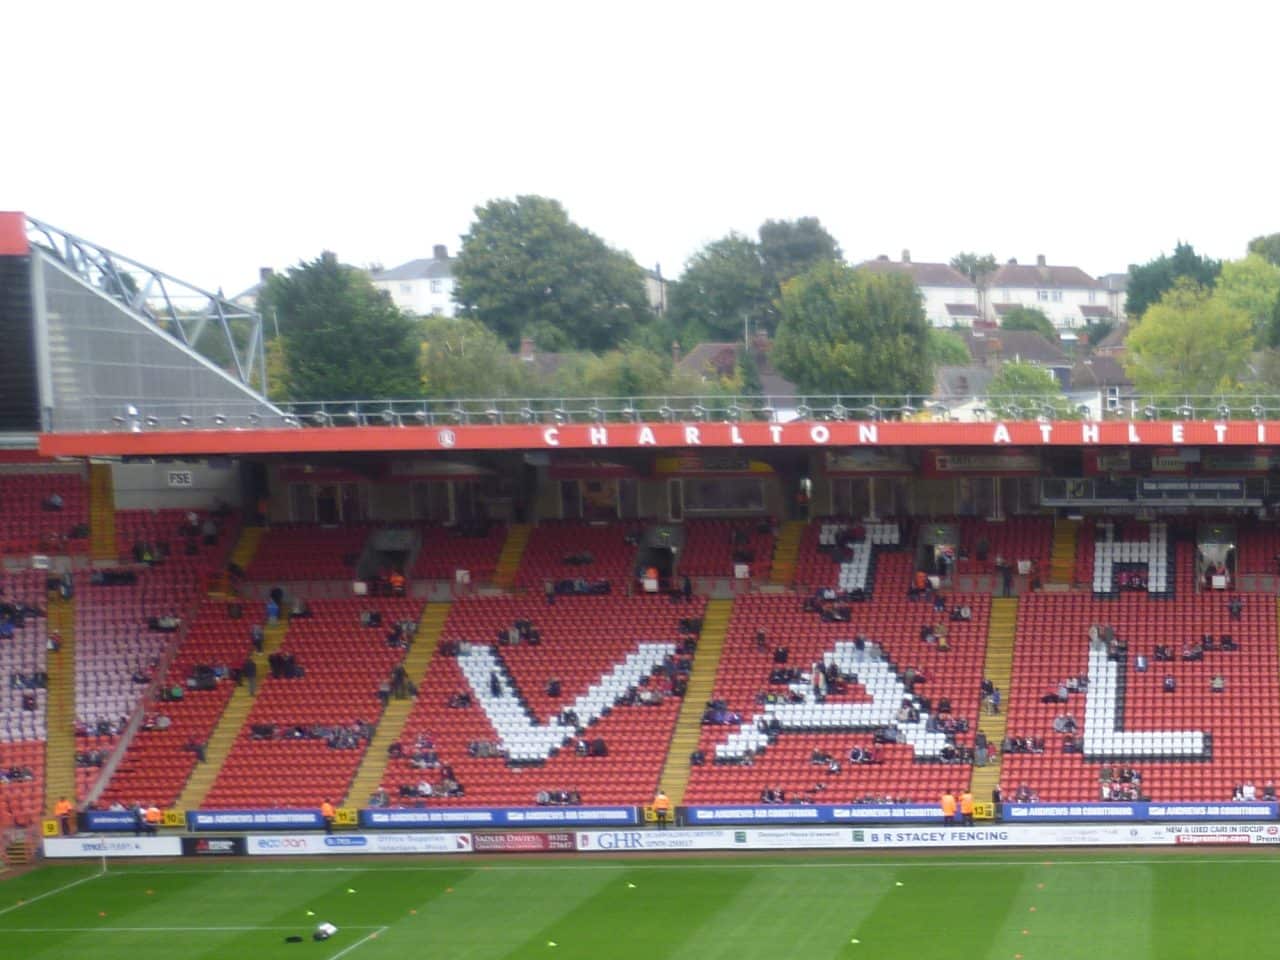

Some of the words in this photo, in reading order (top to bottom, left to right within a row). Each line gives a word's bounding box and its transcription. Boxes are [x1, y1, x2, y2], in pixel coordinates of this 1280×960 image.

[543, 426, 878, 447] CHARLTON
[169, 472, 191, 485] FSE
[597, 832, 644, 850] GHR
[871, 832, 880, 842] B
[884, 832, 893, 842] R
[897, 831, 946, 842] STACEY
[951, 830, 1009, 841] FENCING
